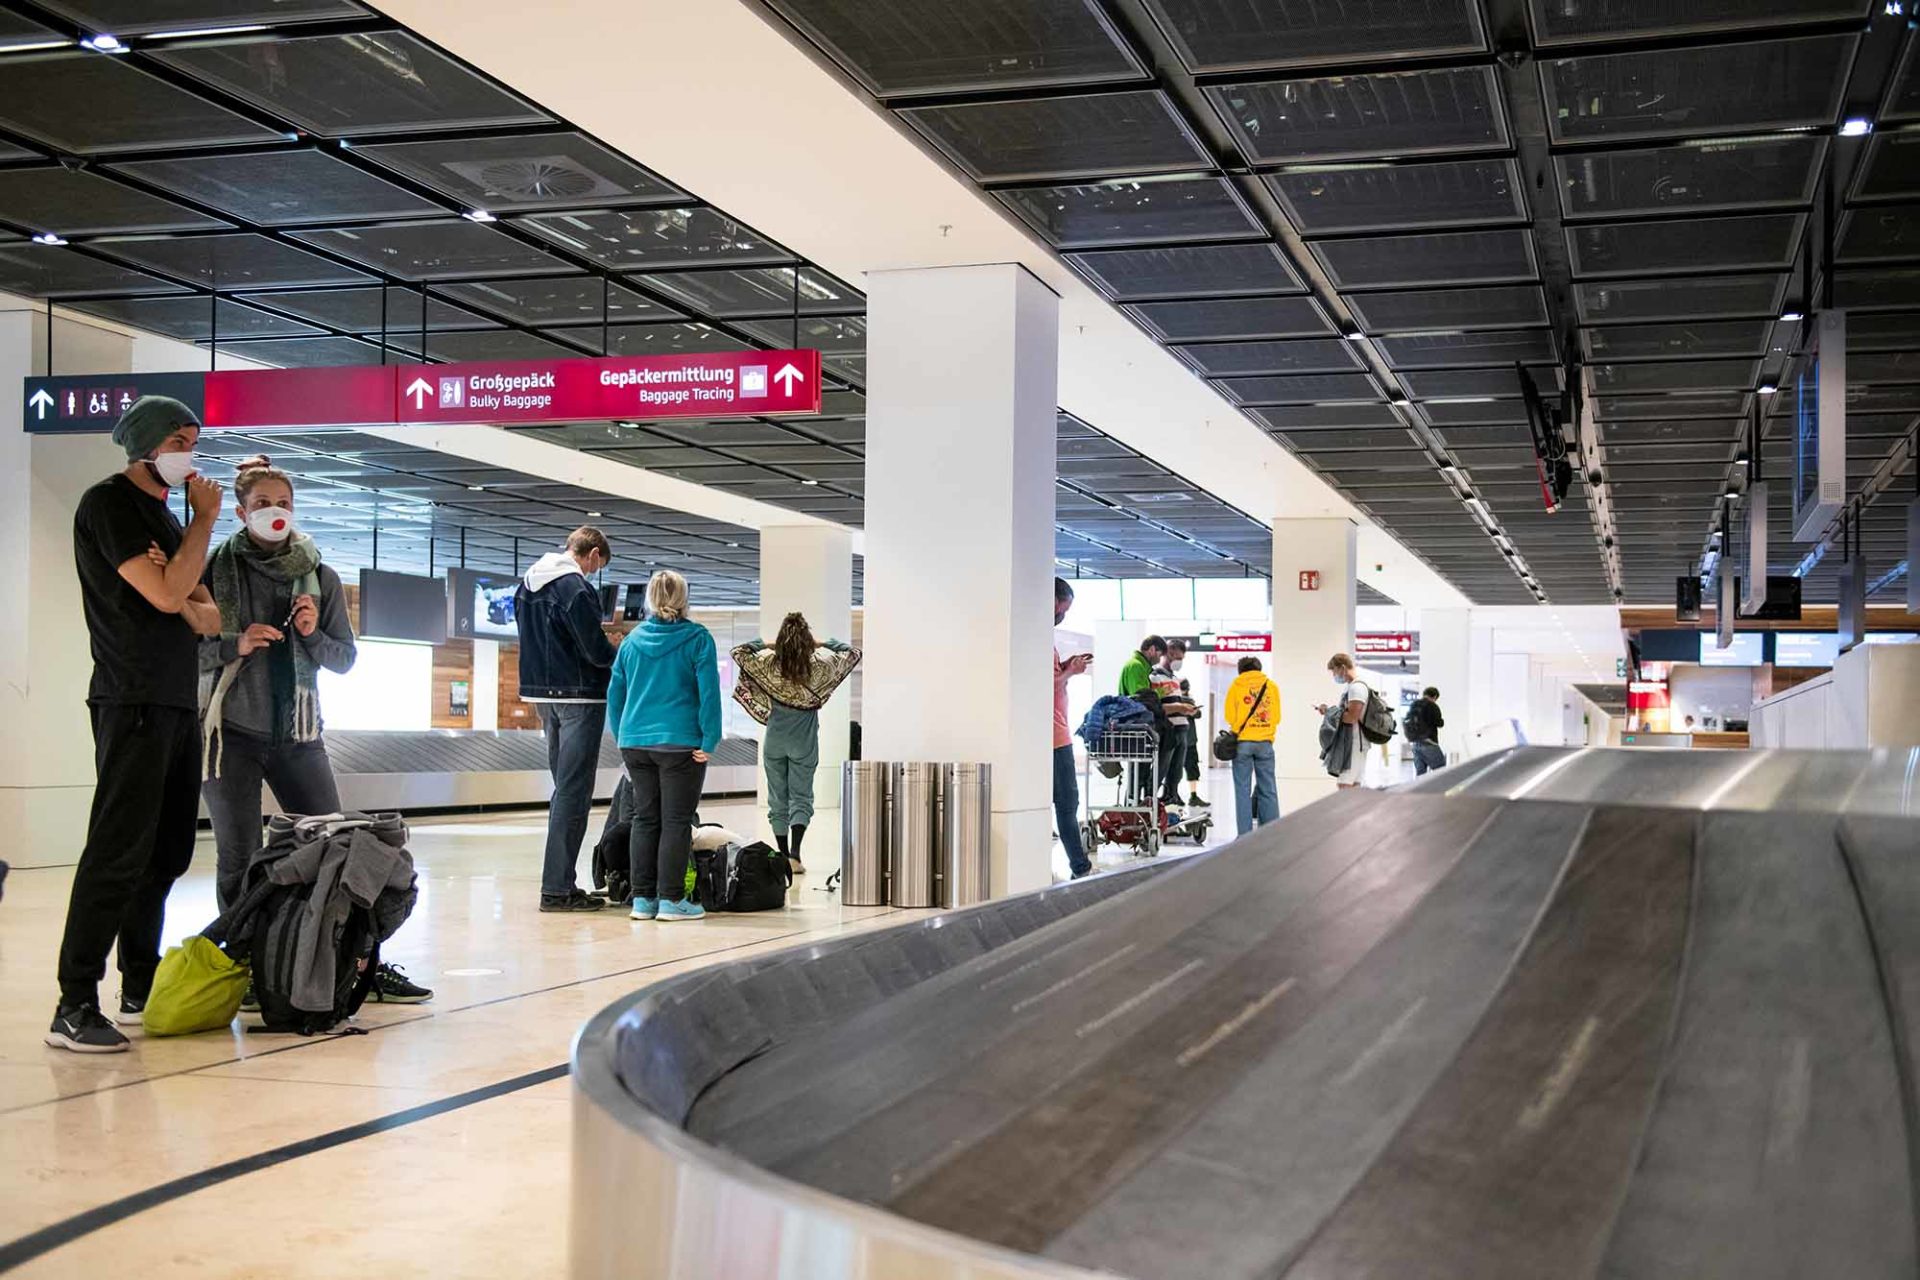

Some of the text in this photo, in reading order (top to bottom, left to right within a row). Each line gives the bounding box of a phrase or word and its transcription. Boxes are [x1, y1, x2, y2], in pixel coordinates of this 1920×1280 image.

[470, 371, 556, 392] Großgepäck
[600, 366, 734, 388] Gepäckermittlung
[470, 394, 552, 410] Bulky Baggage
[639, 386, 735, 404] Baggage Tracing
